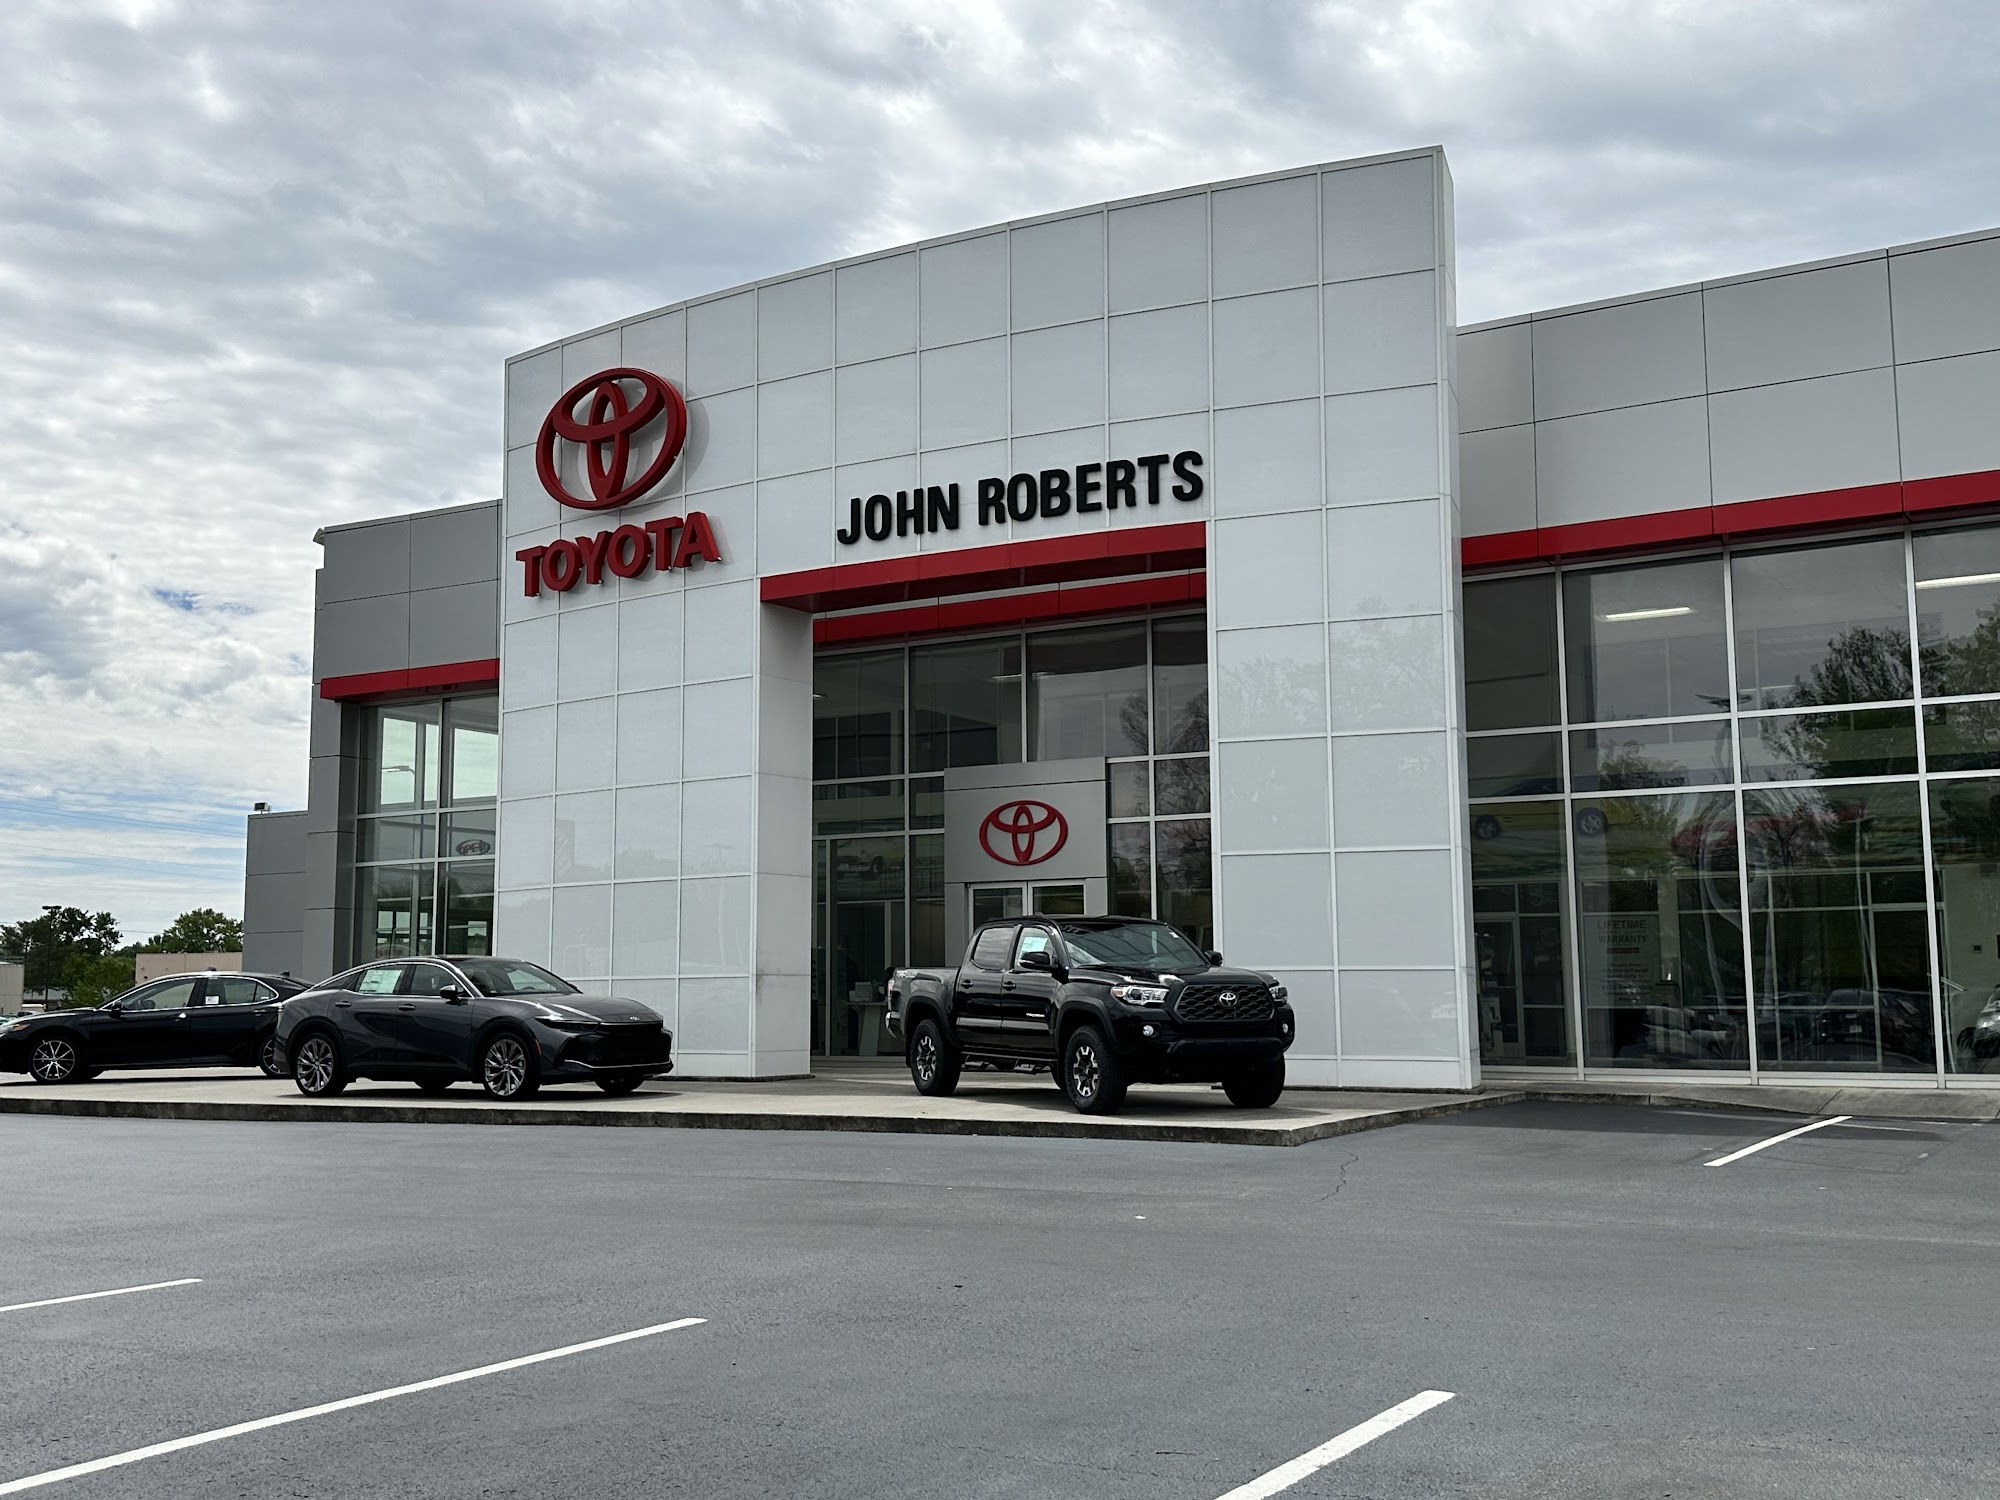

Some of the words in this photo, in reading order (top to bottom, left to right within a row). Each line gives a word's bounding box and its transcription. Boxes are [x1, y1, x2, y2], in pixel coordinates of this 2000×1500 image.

[836, 482, 960, 546] JOHN
[978, 450, 1204, 527] ROBERTS
[516, 511, 721, 597] TOYOTA
[1597, 919, 1647, 930] LIFETIME
[1598, 934, 1647, 944] WARRANTY
